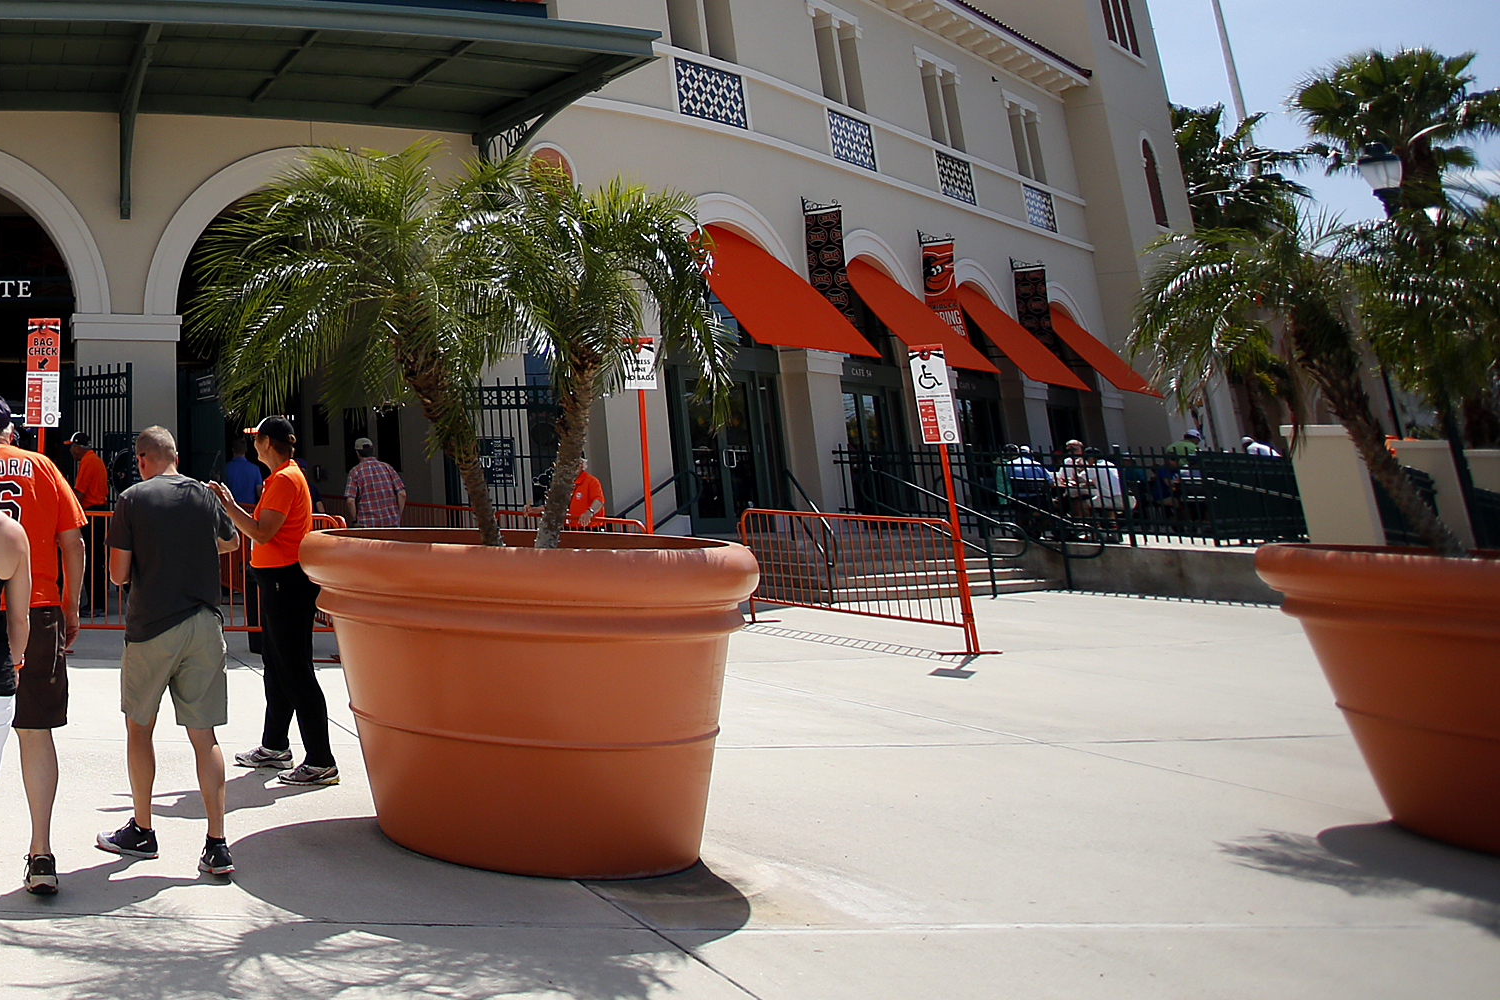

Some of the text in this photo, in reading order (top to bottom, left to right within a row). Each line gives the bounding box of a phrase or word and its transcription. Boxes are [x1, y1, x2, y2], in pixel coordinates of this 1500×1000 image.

[935, 309, 962, 326] RING
[33, 338, 53, 346] BAG
[28, 347, 58, 356] CHECK
